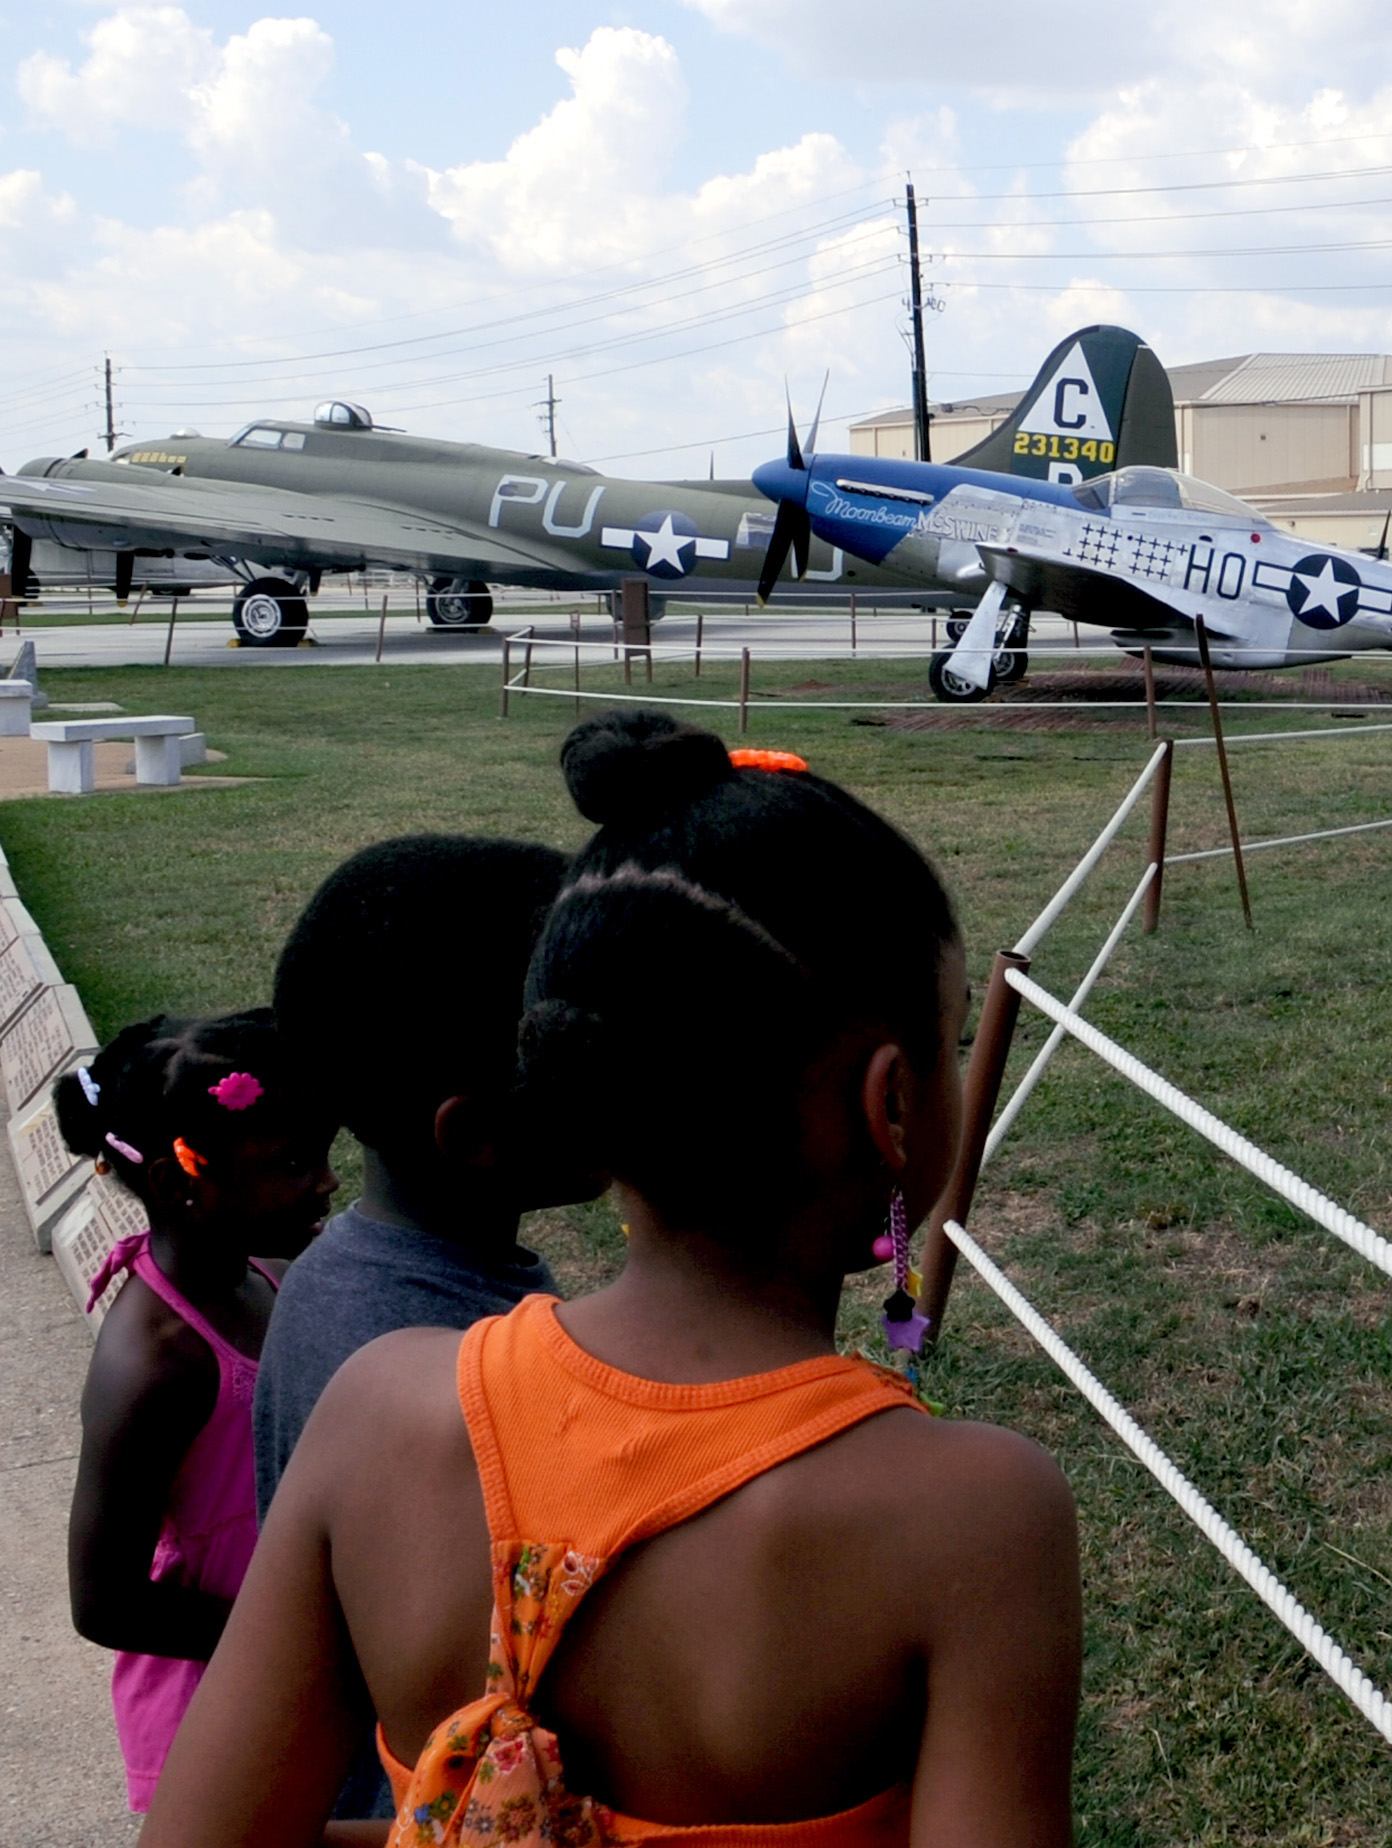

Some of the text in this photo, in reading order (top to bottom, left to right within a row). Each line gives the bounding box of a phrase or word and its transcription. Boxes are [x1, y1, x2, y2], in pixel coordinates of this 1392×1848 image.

[1053, 377, 1089, 429] C
[1013, 432, 1114, 464] 231340
[488, 473, 607, 539] PU
[810, 481, 919, 528] Moonbeam
[1183, 543, 1247, 600] HO
